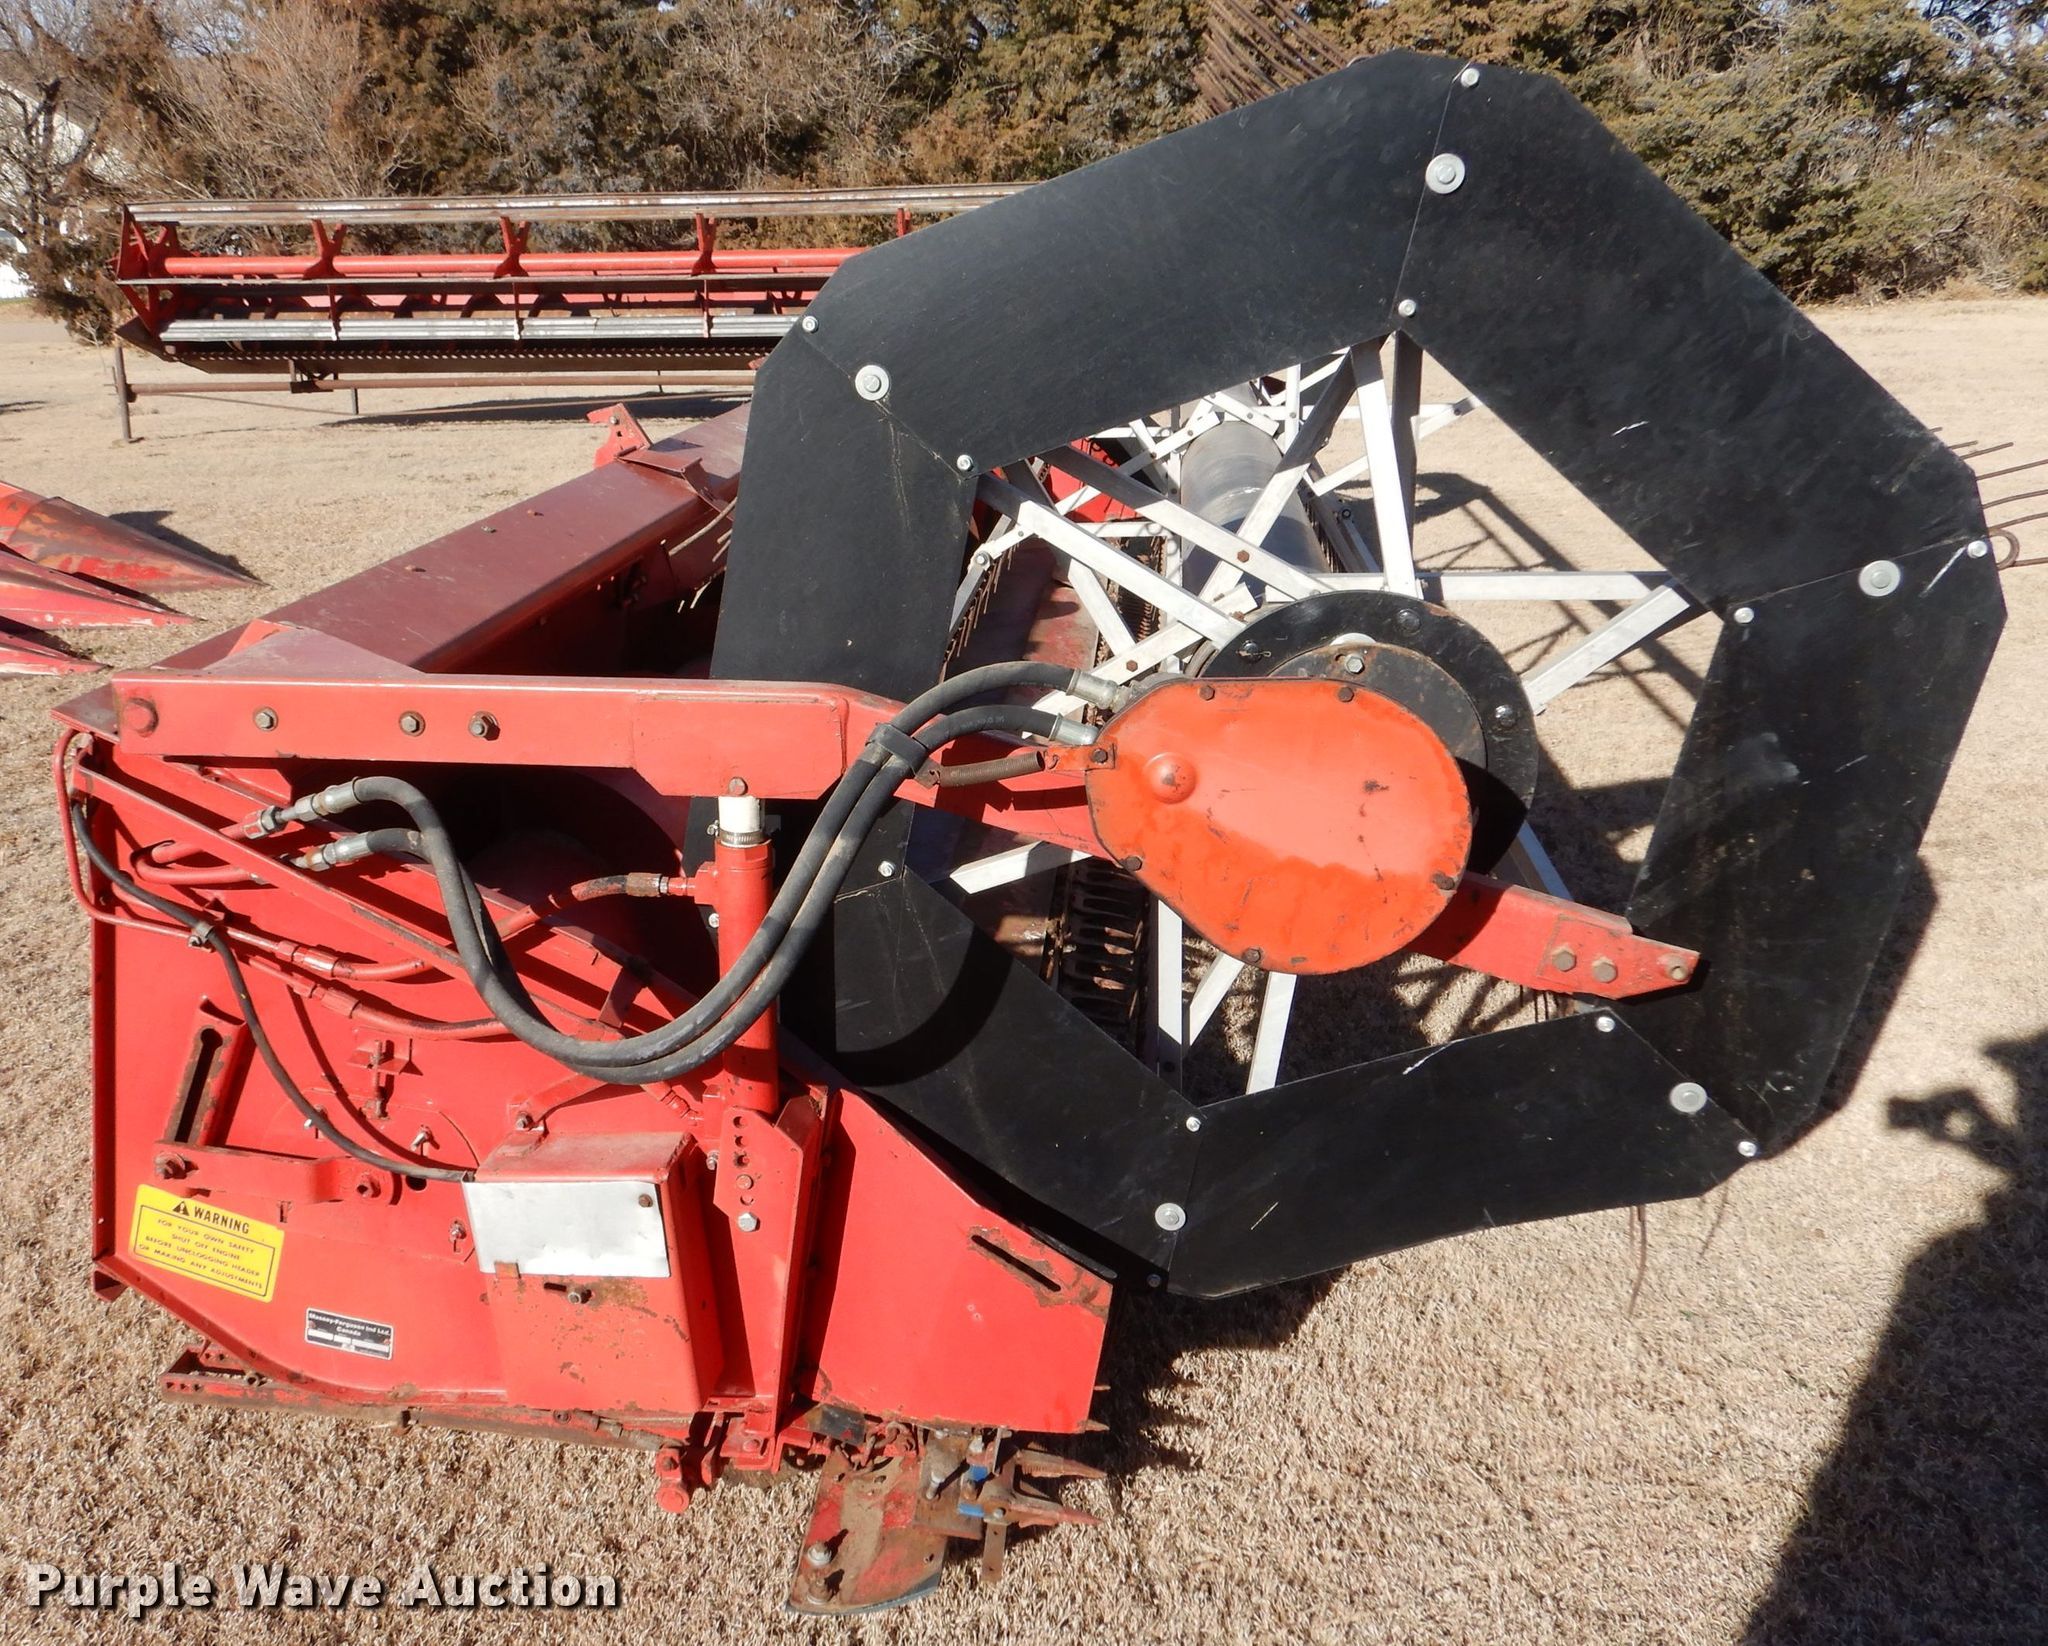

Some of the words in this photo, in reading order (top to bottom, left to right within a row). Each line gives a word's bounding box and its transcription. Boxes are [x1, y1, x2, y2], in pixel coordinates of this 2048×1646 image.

[194, 1206, 250, 1234] WARNING
[172, 1233, 191, 1244] SHUT
[194, 1241, 208, 1250] OFF
[212, 1247, 240, 1261] ENGINE
[178, 1225, 199, 1236] YOUR
[203, 1233, 224, 1244] OWN
[229, 1241, 255, 1254] SAFETY
[139, 1243, 150, 1251] OR
[154, 1249, 186, 1264] MAKING
[190, 1261, 207, 1270] ANY
[211, 1268, 262, 1289] ADJUSTMENTS
[145, 1235, 172, 1248] BEFORE
[176, 1245, 229, 1267] UNCLOGGING
[231, 1263, 260, 1277] HEADER
[336, 1326, 361, 1336] Canada
